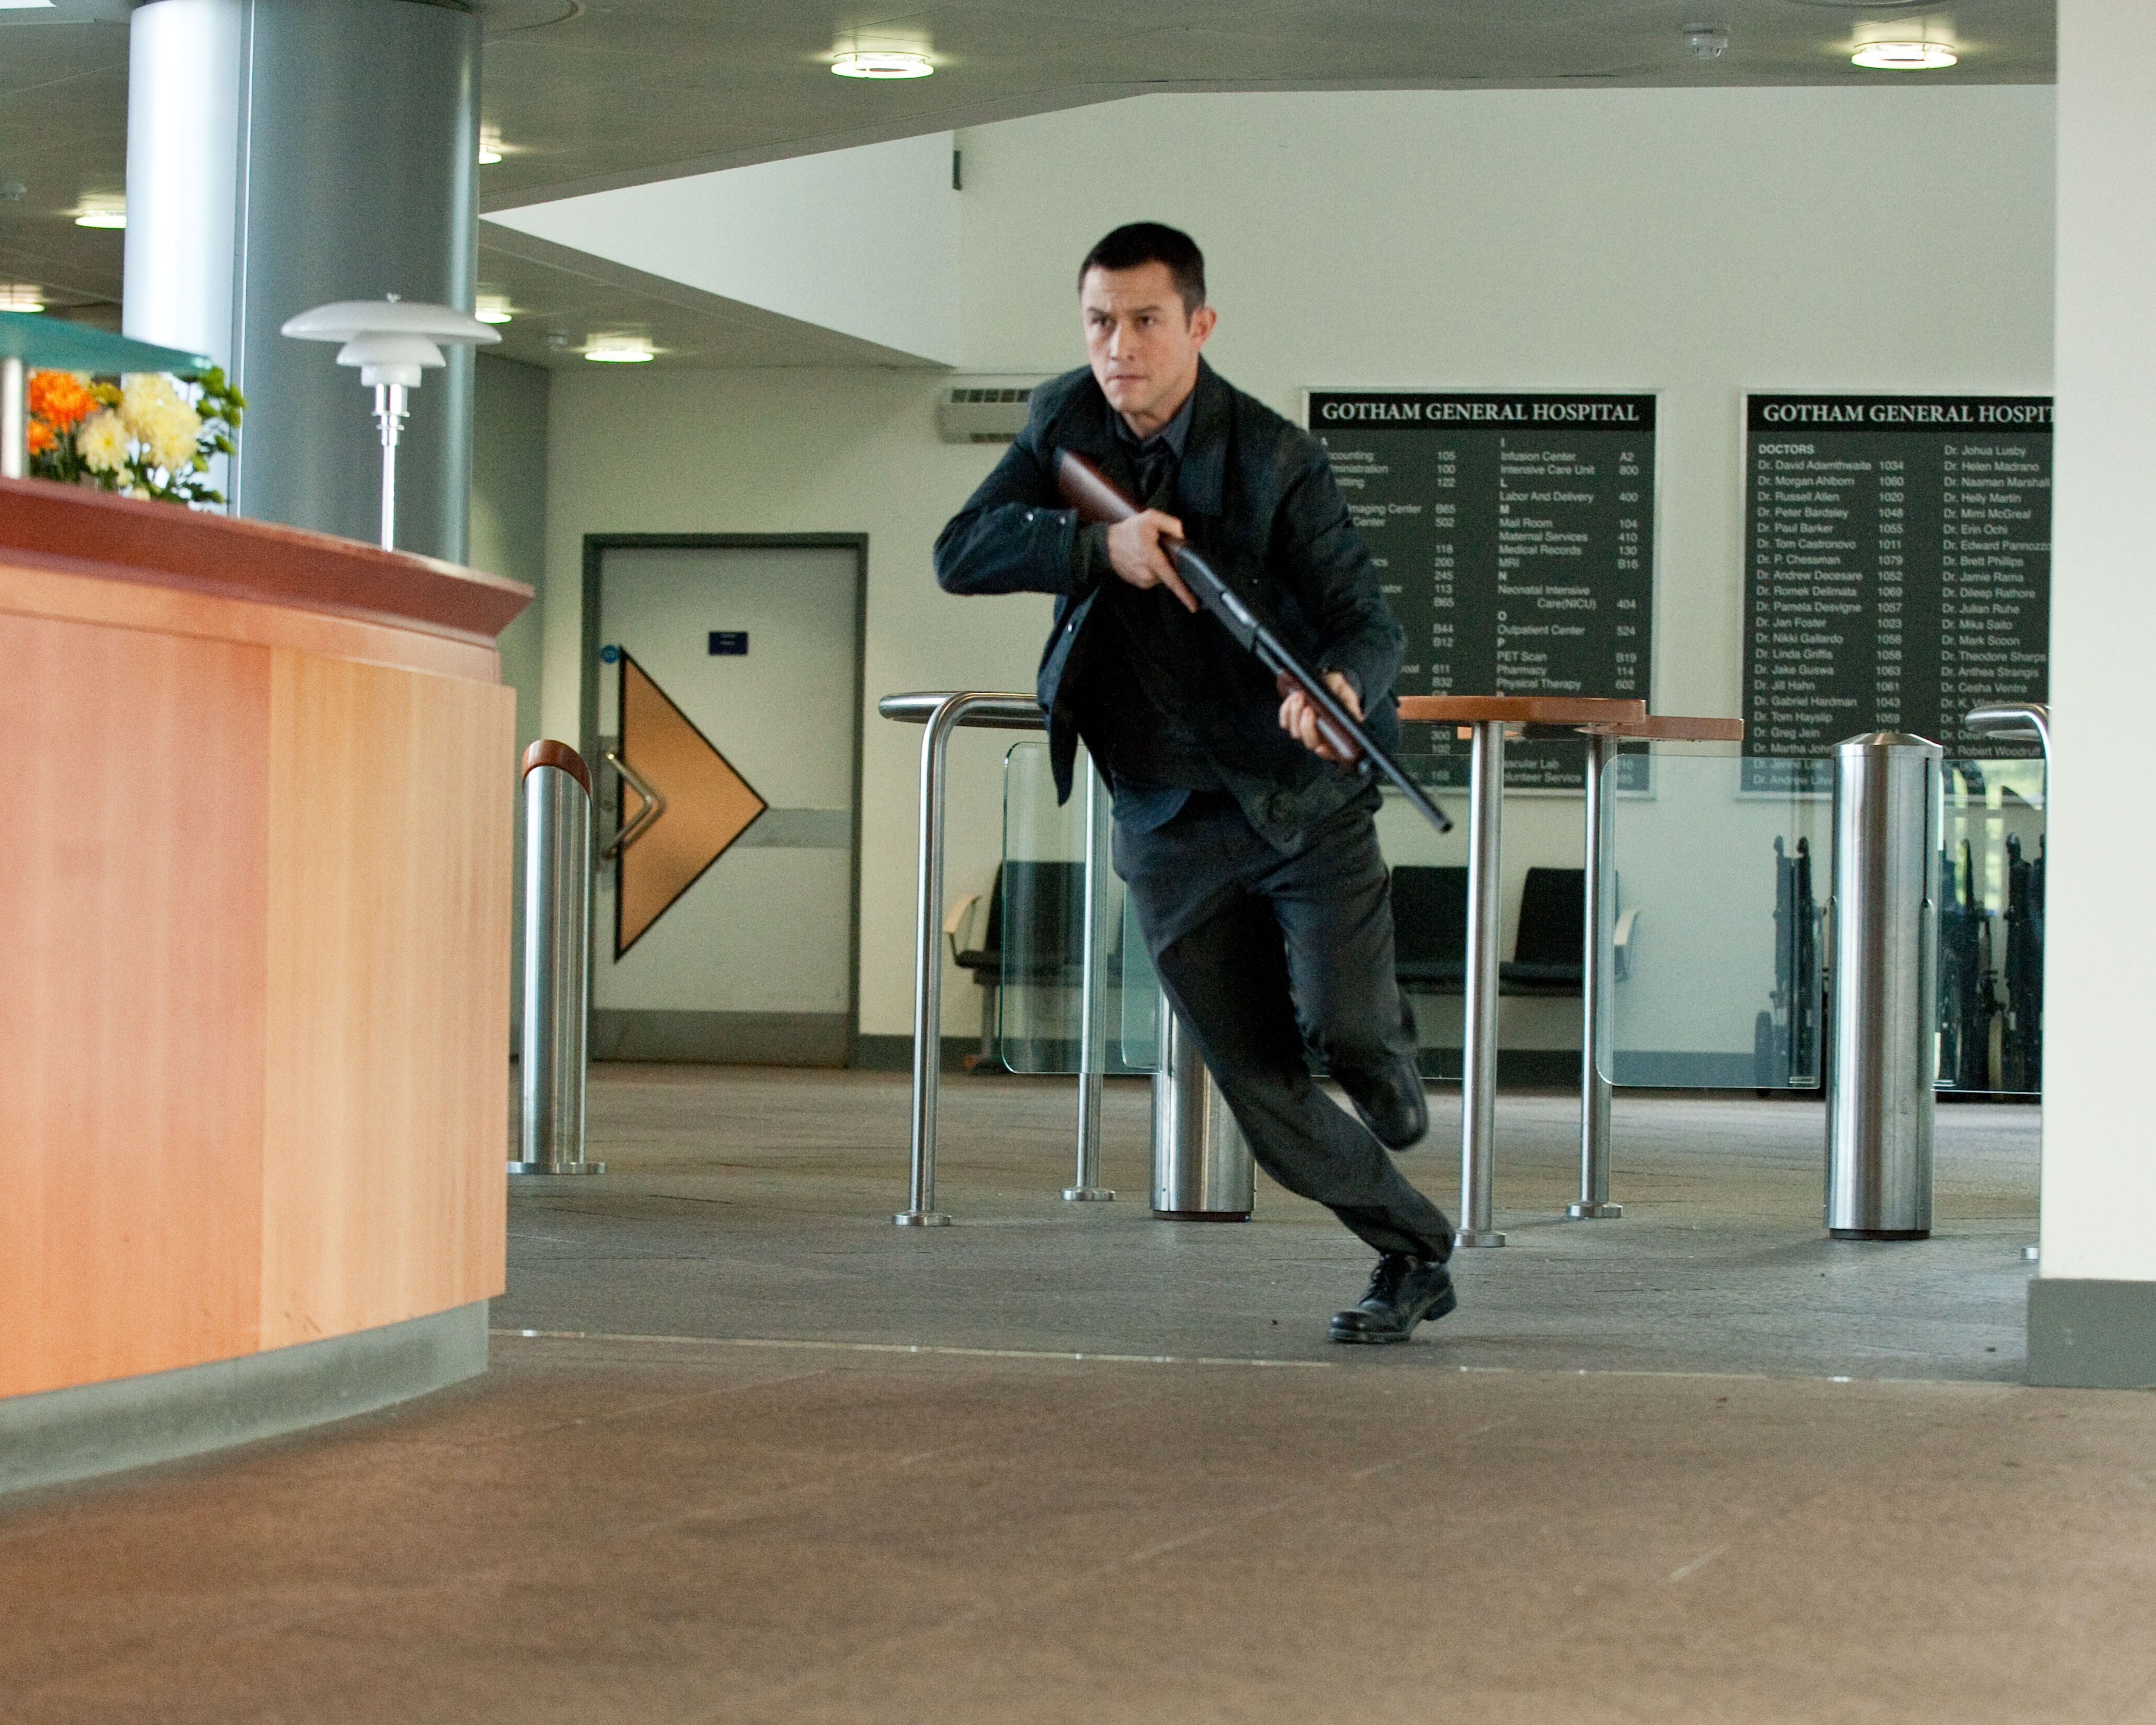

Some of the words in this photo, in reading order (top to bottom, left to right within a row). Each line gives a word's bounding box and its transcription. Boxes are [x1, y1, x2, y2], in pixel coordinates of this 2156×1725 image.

[1322, 403, 1421, 420] GOTHAM
[1425, 403, 1528, 420] GENERAL
[1533, 404, 1639, 421] HOSPITAL
[1763, 404, 1864, 422] GOTHAM
[1869, 405, 1974, 422] GENERAL
[1758, 444, 1815, 455] DOCTORS
[1327, 451, 1374, 463] ccounting
[1500, 451, 1540, 462] Infusion
[1541, 451, 1576, 462] Center
[1619, 452, 1635, 462] A2
[1500, 465, 1546, 475] Intensive
[1547, 464, 1573, 475] Care
[1574, 465, 1595, 475] Unit
[1775, 459, 1805, 470] David
[1879, 460, 1904, 470] 1034
[1500, 478, 1508, 488] L
[1775, 475, 1815, 488] Morgan
[1499, 491, 1529, 501] Labor
[1530, 491, 1551, 502] And
[1553, 491, 1594, 504] Delivery
[1619, 492, 1639, 502] 400
[1347, 504, 1387, 516] Imaging
[1387, 503, 1422, 514] Center
[1500, 504, 1510, 514] M
[1775, 507, 1802, 518] Peter
[1353, 516, 1386, 527] Center
[1499, 518, 1521, 528] Mail
[1522, 518, 1553, 528] Room
[1619, 519, 1638, 529] 104
[1774, 522, 1798, 533] Paul
[1800, 522, 1834, 533] Barker
[1960, 523, 1982, 535] Erin
[1545, 531, 1589, 542] Services
[1618, 532, 1638, 543] 410
[1774, 538, 1796, 549] Tom
[1879, 539, 1902, 550] 1011
[1960, 539, 2000, 551] Edward
[1499, 545, 1538, 555] Medical
[1539, 544, 1582, 556] Records
[1498, 558, 1520, 568] MRI
[1498, 571, 1507, 581] N
[1773, 570, 1812, 581] Andrew
[1498, 584, 1543, 595] Neonatal
[1545, 585, 1590, 596] Intensive
[1616, 599, 1636, 609] 404
[1497, 610, 1507, 622] O
[1794, 617, 1827, 628] Foster
[1497, 623, 1549, 636] Outpatient
[1551, 624, 1585, 635] Center
[1497, 637, 1506, 647] P
[1497, 650, 1519, 661] PET
[1521, 651, 1547, 662] Scan
[1772, 649, 1802, 660] Linda
[1496, 664, 1547, 677] Pharmacy
[1617, 666, 1635, 676] 114
[1496, 677, 1538, 690] Physical
[1540, 678, 1582, 691] Therapy
[1771, 695, 1809, 707] Gabriel
[1771, 711, 1793, 722] Tom
[1503, 759, 1538, 769] ascular
[1540, 759, 1560, 769] Lab
[1504, 772, 1542, 784] olunteer
